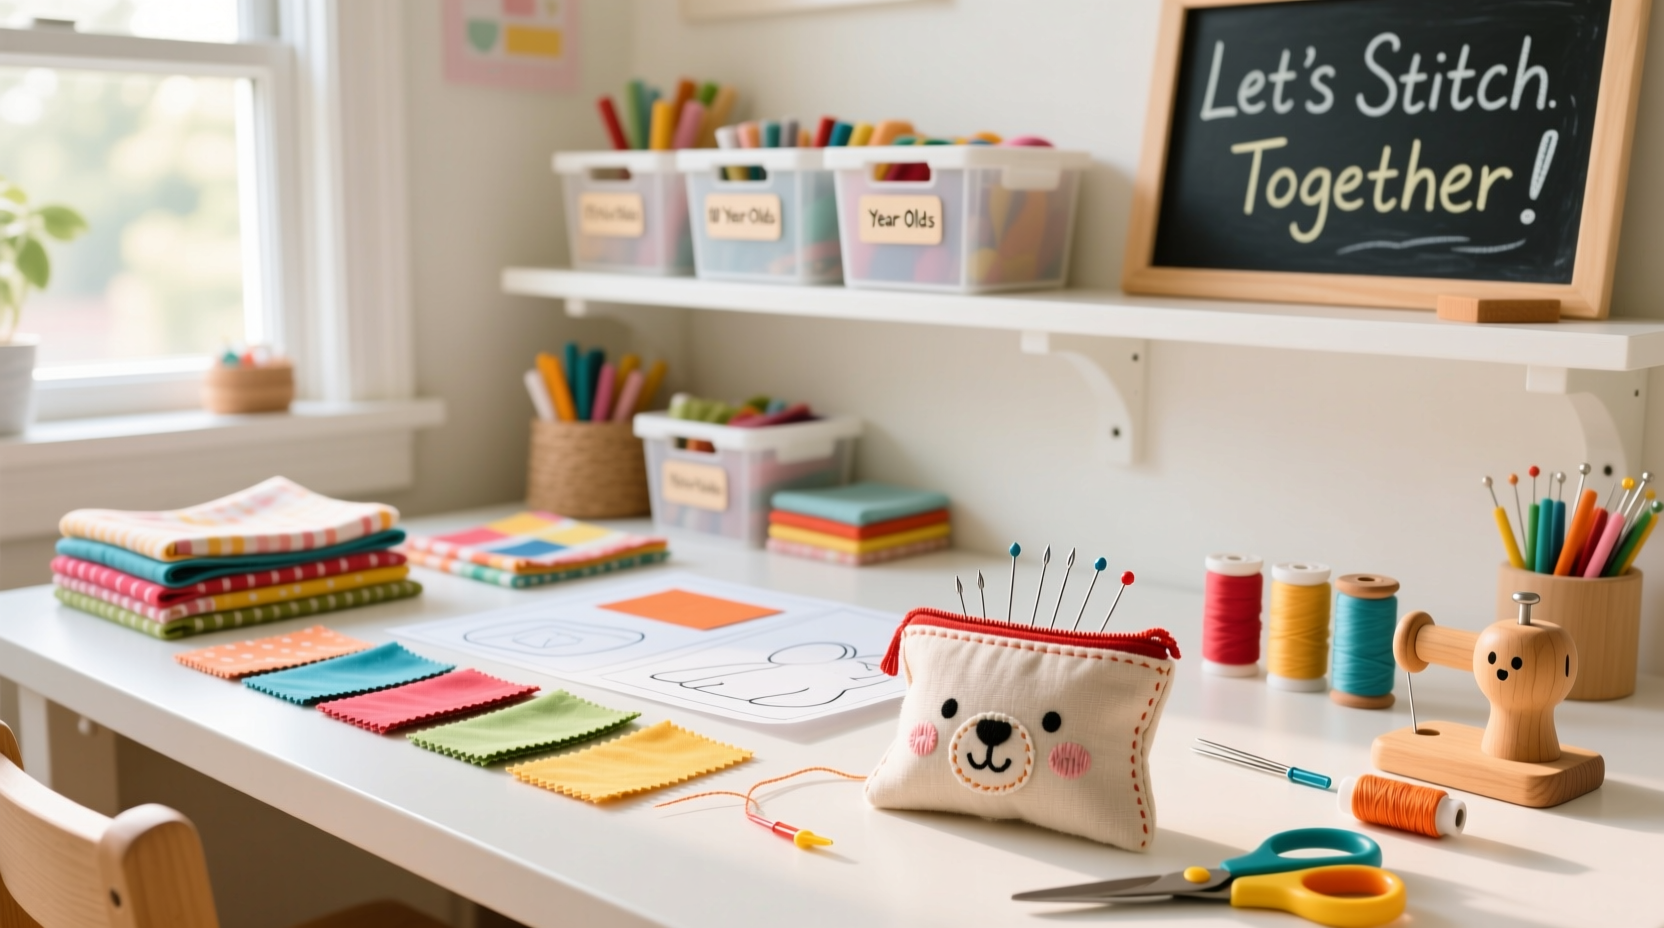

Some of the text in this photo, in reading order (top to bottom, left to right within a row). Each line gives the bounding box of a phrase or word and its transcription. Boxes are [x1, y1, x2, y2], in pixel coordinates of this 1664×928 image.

[1201, 32, 1557, 121] Let’s Stitch.
[868, 208, 935, 228] Year Olds
